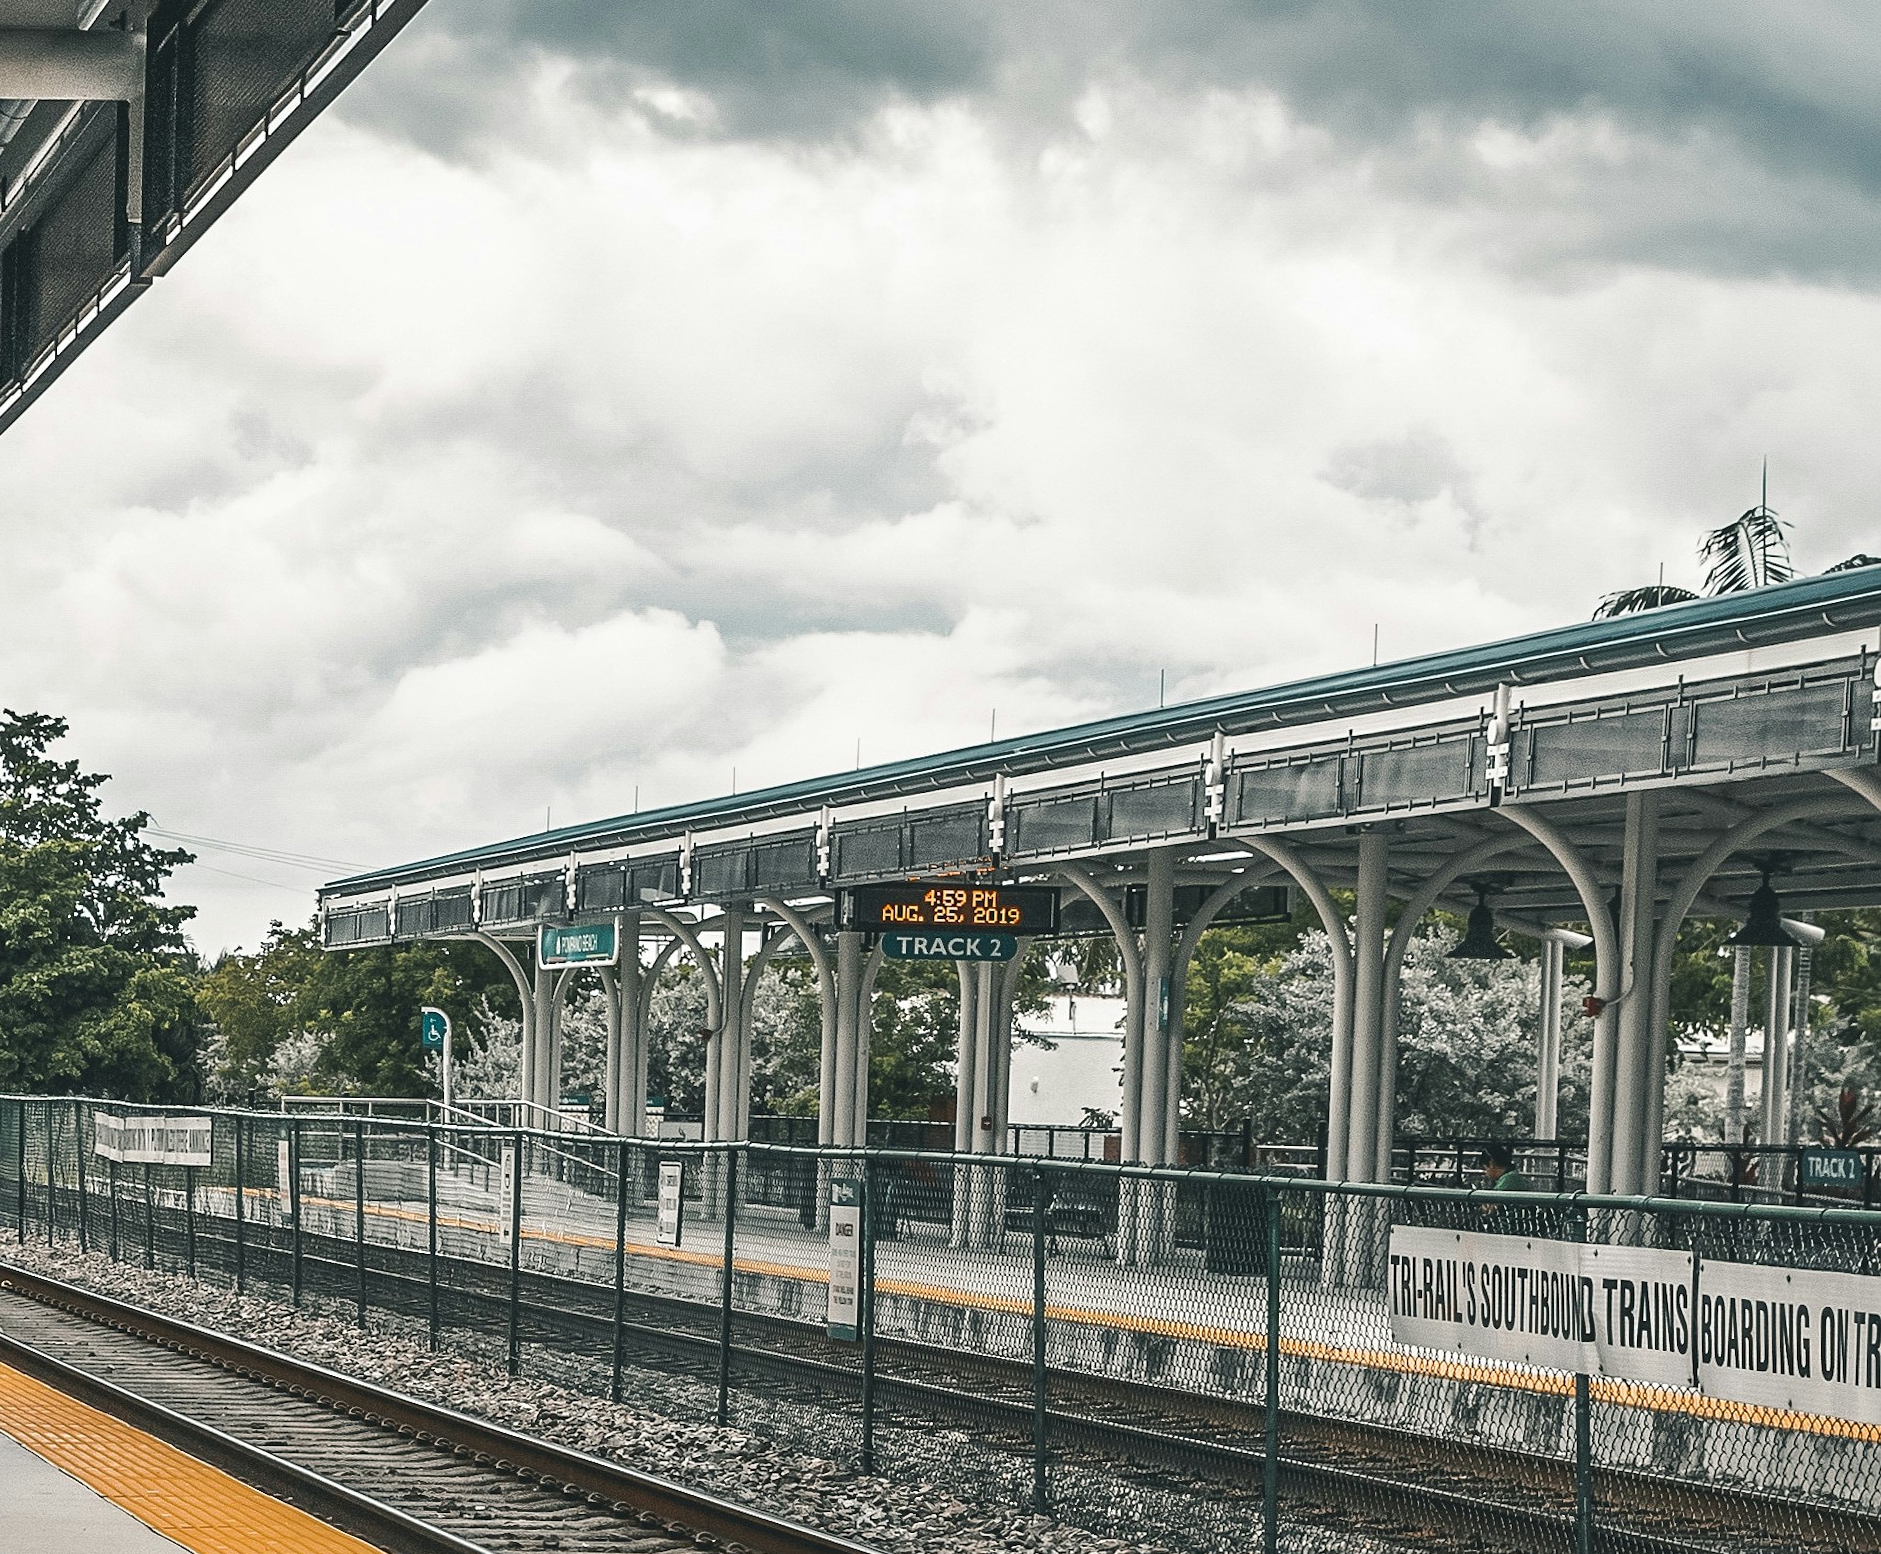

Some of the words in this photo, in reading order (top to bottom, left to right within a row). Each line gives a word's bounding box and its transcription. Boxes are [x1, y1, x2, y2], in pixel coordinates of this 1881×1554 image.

[924, 889, 967, 907] 4:59
[971, 890, 998, 908] PM
[882, 905, 924, 922] AUG.
[933, 906, 965, 923] 25,
[973, 907, 1020, 924] 2019
[896, 936, 983, 957] TRACK
[990, 939, 1002, 957] 2
[1808, 1156, 1846, 1179] TRACK
[1848, 1158, 1855, 1179] 2
[1390, 1254, 1476, 1326] TRI-RAIL'S
[1480, 1262, 1596, 1343] SOUTHBOUND
[1602, 1278, 1688, 1355] TRAINS
[1701, 1294, 1811, 1379] BOARDING
[1820, 1306, 1849, 1384] ON
